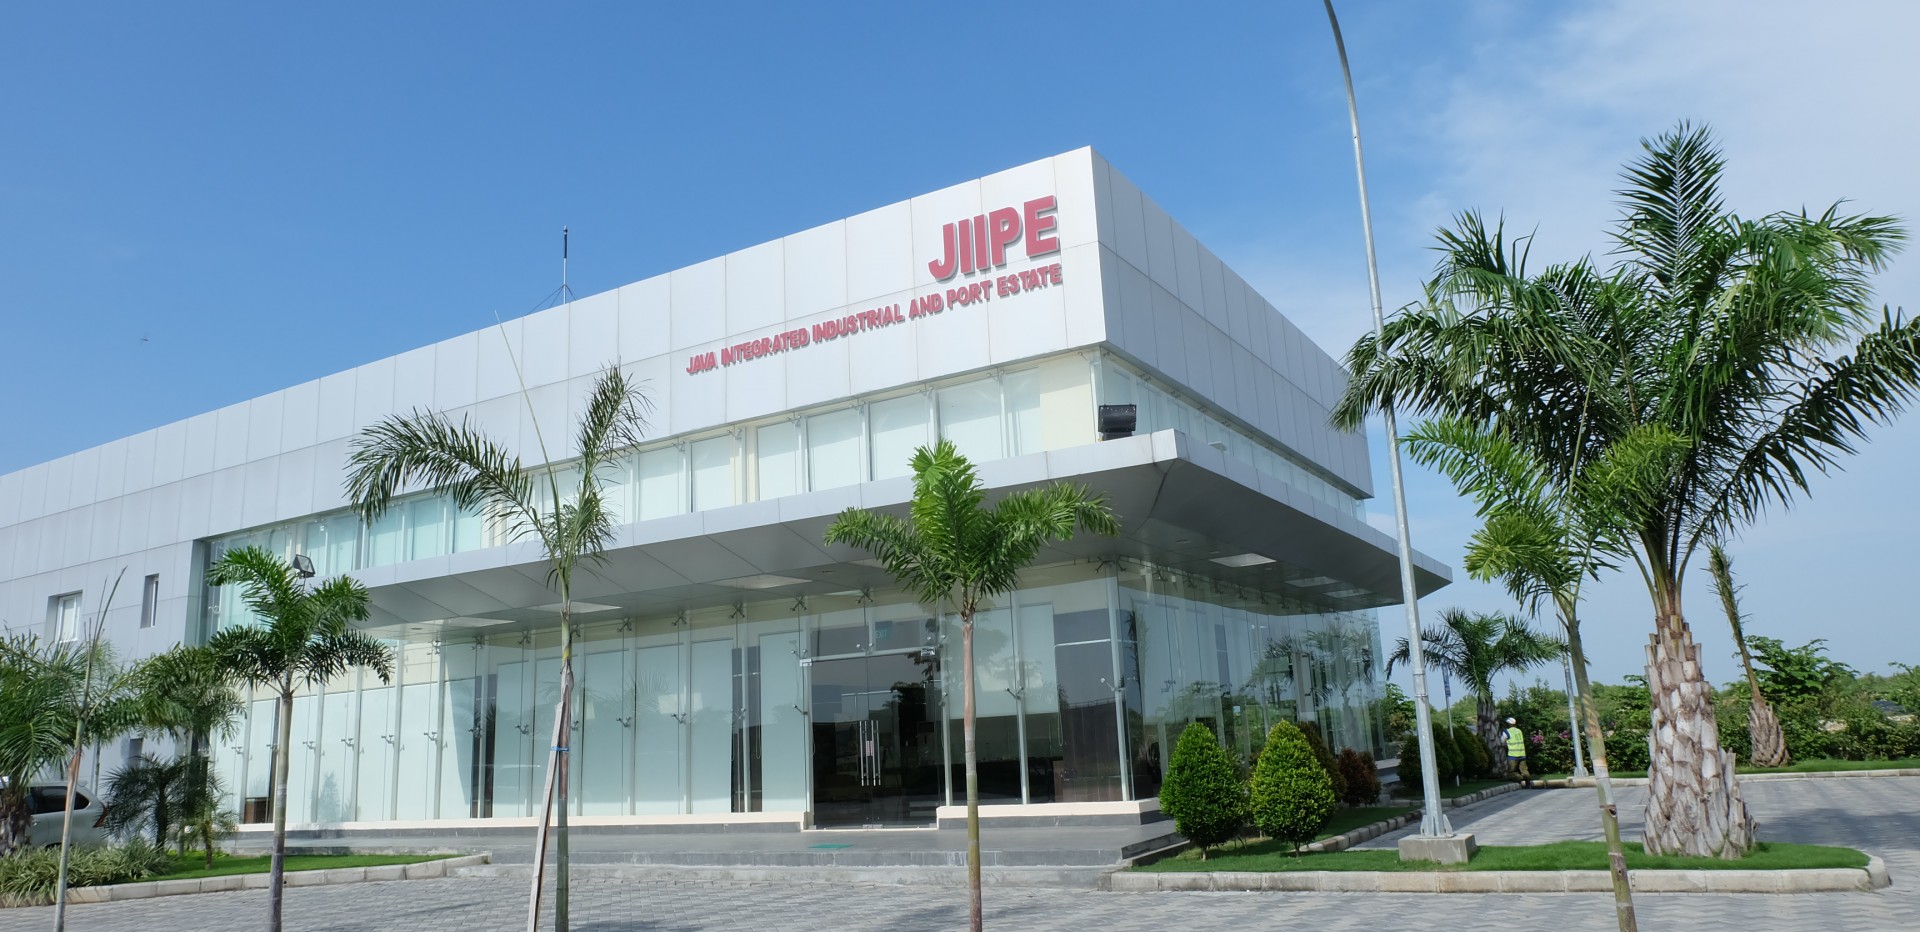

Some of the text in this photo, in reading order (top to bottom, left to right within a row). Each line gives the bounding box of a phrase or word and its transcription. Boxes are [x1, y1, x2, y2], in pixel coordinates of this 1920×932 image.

[927, 194, 1060, 281] JIIPE
[686, 262, 1063, 374] JAVA INTEGRATED INDUSTRIAL AND PORT ESTATE
